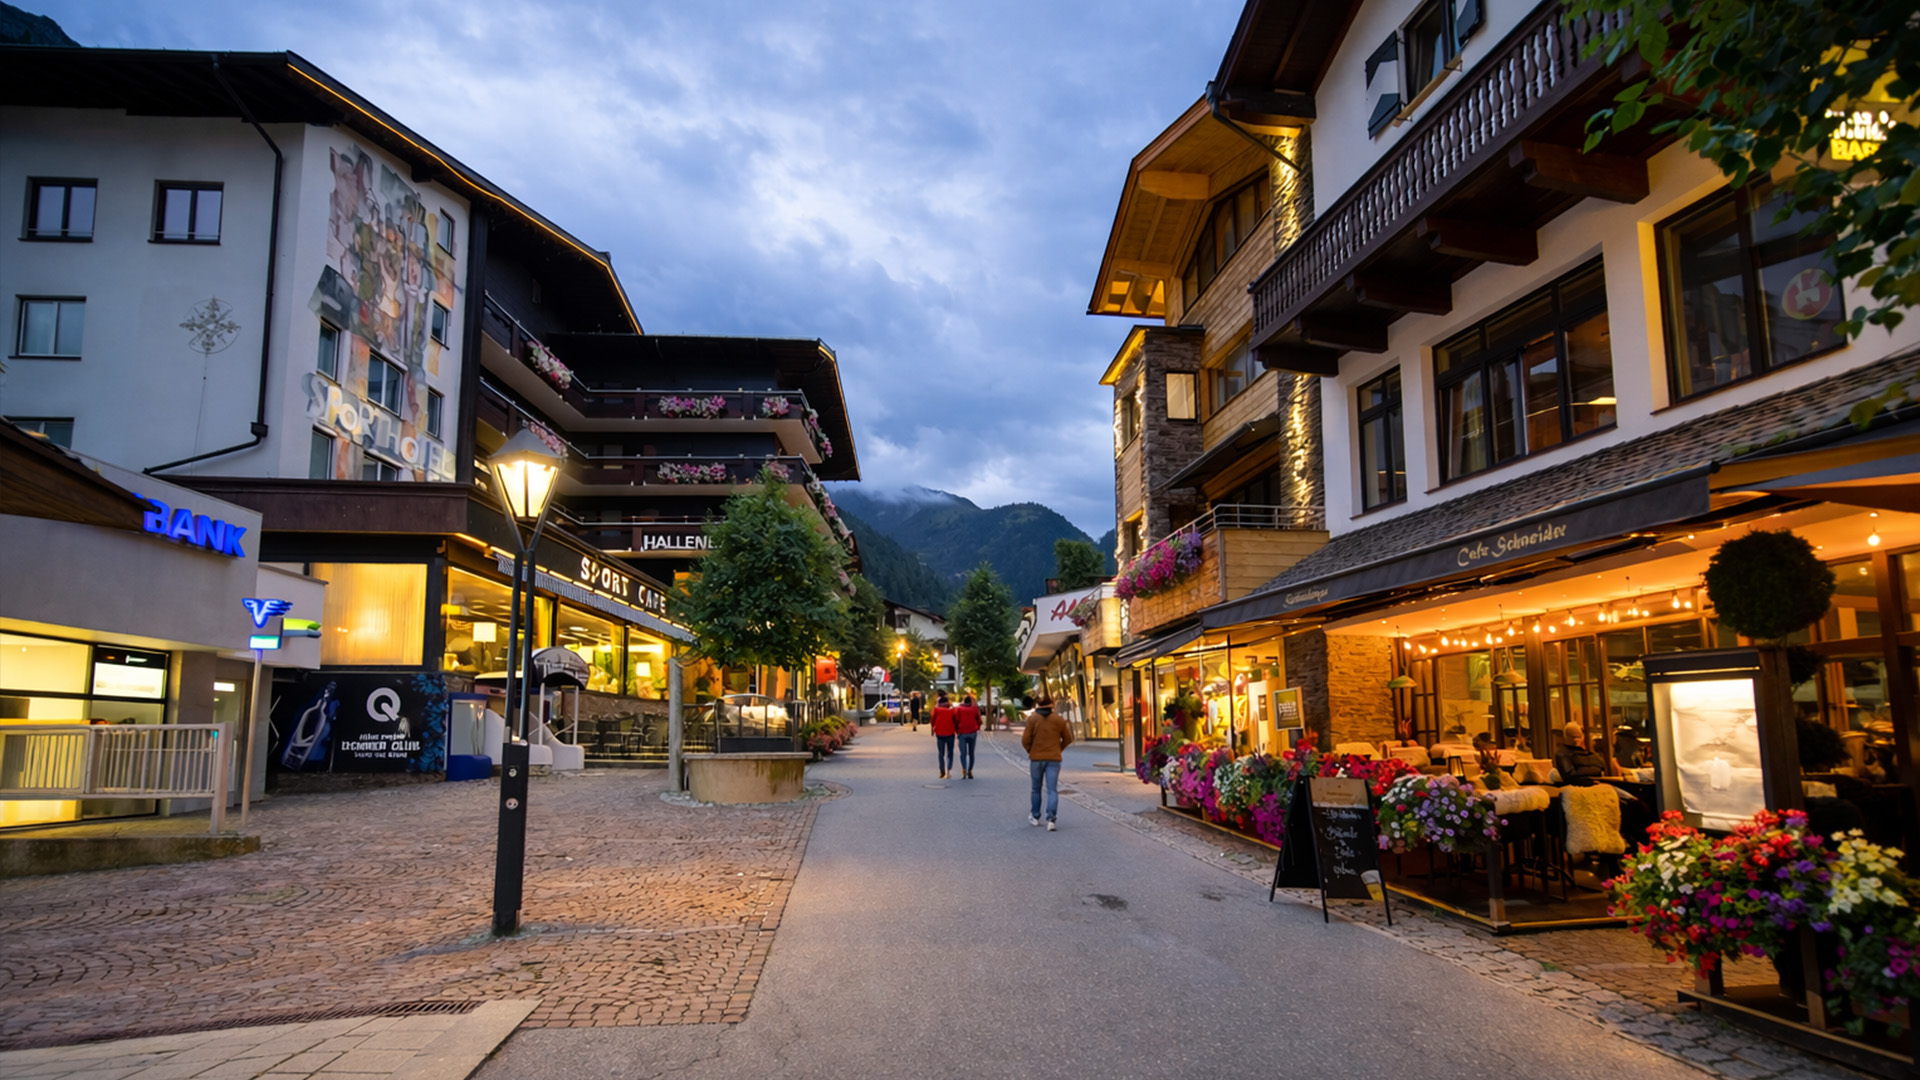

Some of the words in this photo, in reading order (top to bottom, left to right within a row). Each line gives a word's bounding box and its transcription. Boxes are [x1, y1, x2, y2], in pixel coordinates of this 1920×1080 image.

[134, 493, 247, 558] BANK
[580, 557, 629, 597] SPORT
[366, 687, 401, 721] Q
